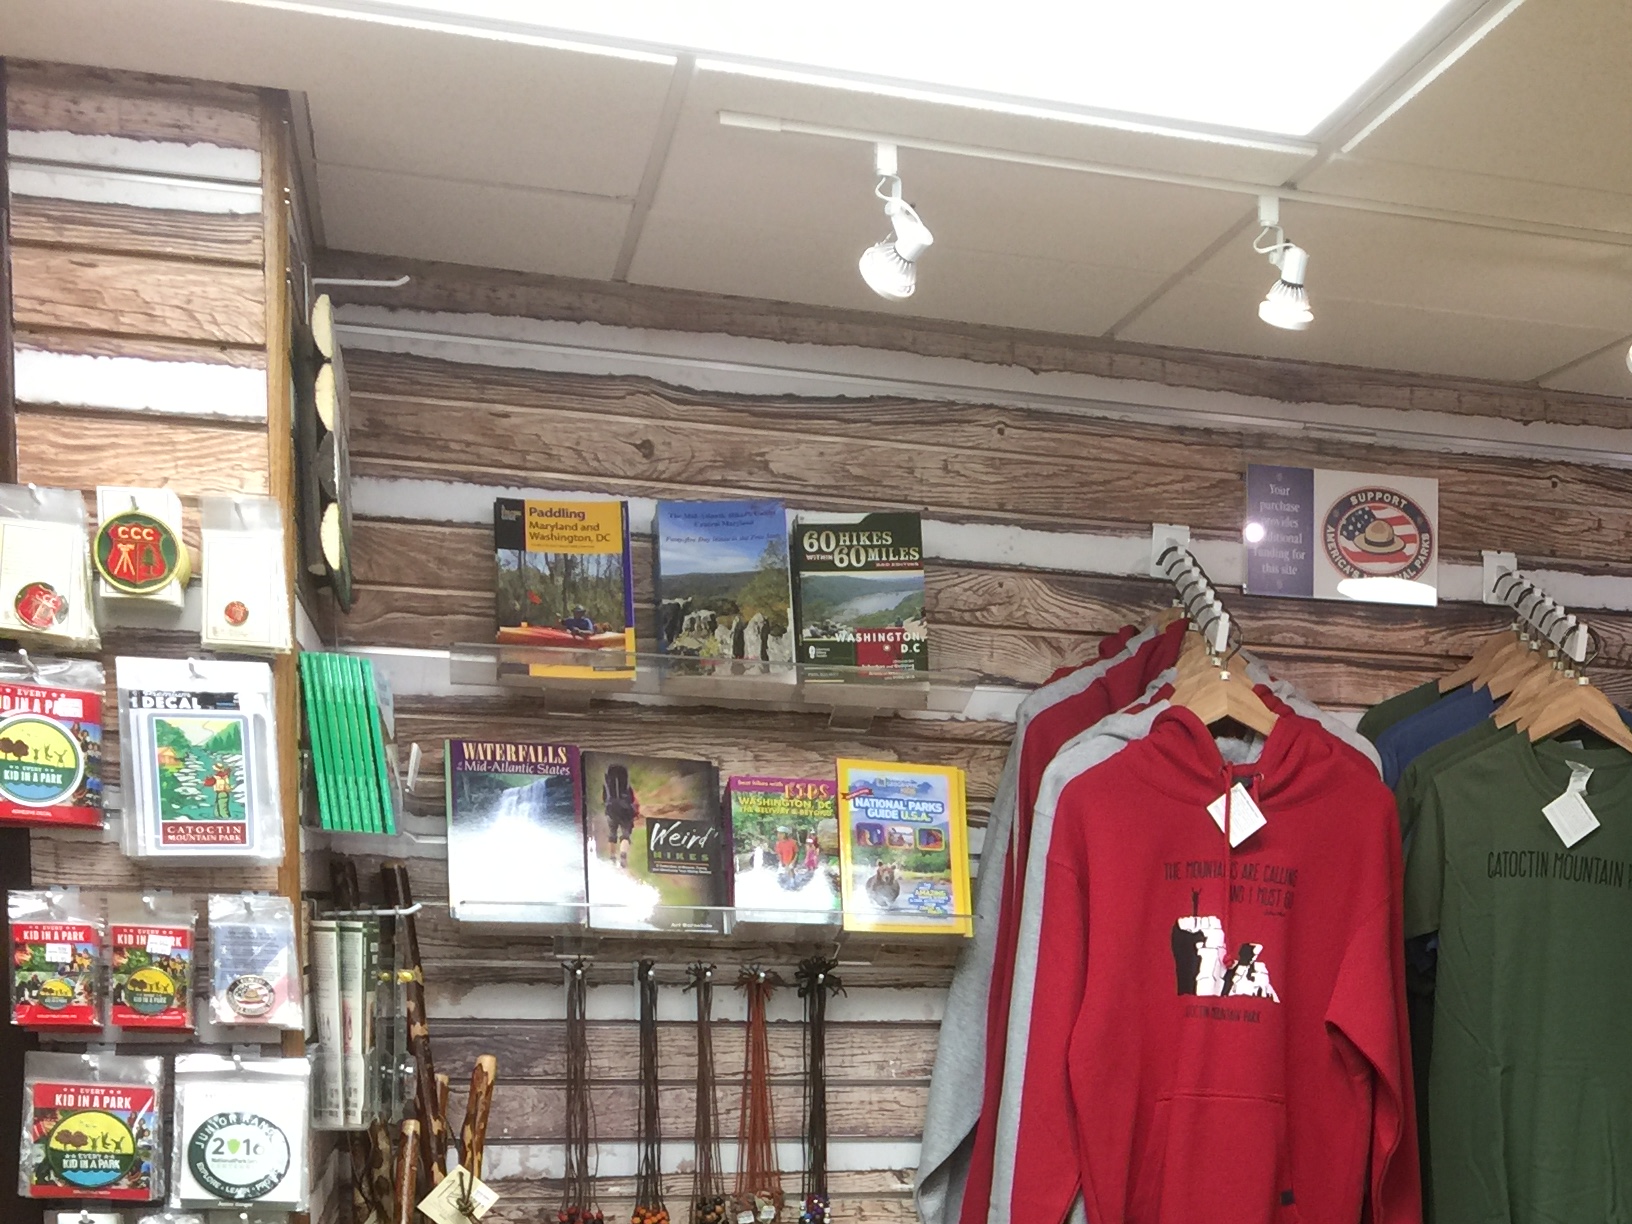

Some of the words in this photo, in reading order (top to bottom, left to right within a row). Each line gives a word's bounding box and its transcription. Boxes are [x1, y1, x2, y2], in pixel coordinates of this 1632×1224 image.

[1269, 484, 1290, 496] Your
[1259, 501, 1300, 513] purchase
[1349, 491, 1408, 509] SUPPORT
[528, 506, 586, 522] Paddling
[117, 526, 155, 542] CCC
[528, 522, 578, 533] Maryland
[579, 522, 600, 531] and
[596, 533, 611, 542] DC
[803, 530, 837, 552] 60
[839, 531, 893, 545] HIKES
[833, 545, 867, 567] 60
[867, 547, 920, 561] MILES
[1292, 549, 1306, 560] for
[1415, 533, 1430, 572] PARKS
[1262, 564, 1279, 574] this
[1281, 565, 1298, 575] site
[835, 632, 925, 643] WASHINGTON,
[33, 699, 42, 713] A
[142, 697, 201, 709] DECAL
[462, 743, 567, 764] WATERFALLS
[464, 761, 534, 774] Mid-Atlantic
[537, 764, 571, 776] States
[3, 770, 19, 781] KID
[21, 771, 31, 782] IN
[32, 772, 39, 783] A
[40, 772, 63, 784] PARK
[817, 799, 832, 810] DC
[855, 798, 906, 811] NATIONAL
[908, 800, 943, 813] PARKS
[867, 809, 899, 820] GUIDE
[167, 826, 242, 834] CATOCTIN
[650, 821, 712, 850] Weird
[167, 834, 217, 842] MOUNTAIN
[219, 834, 241, 842] PARK
[653, 851, 710, 861] HIKES
[1164, 862, 1182, 881] THE
[1241, 863, 1258, 883] ARE
[1262, 865, 1298, 888] CALLING
[1487, 851, 1549, 879] CATOCTIN
[1553, 852, 1625, 888] MOUNTAIN
[1257, 887, 1281, 907] MUST
[23, 930, 39, 941] KID
[41, 930, 52, 941] IN
[53, 931, 60, 941] A
[61, 931, 85, 942] PARK
[117, 934, 134, 945] KID
[136, 935, 146, 946] IN
[55, 1094, 75, 1107] KID
[78, 1095, 90, 1107] IN
[92, 1096, 100, 1108] A
[103, 1096, 131, 1109] PARK
[195, 1114, 238, 1150] JUNIOR
[63, 1159, 78, 1169] KID
[80, 1159, 88, 1169] IN
[90, 1160, 98, 1169] A
[98, 1160, 120, 1170] PARK
